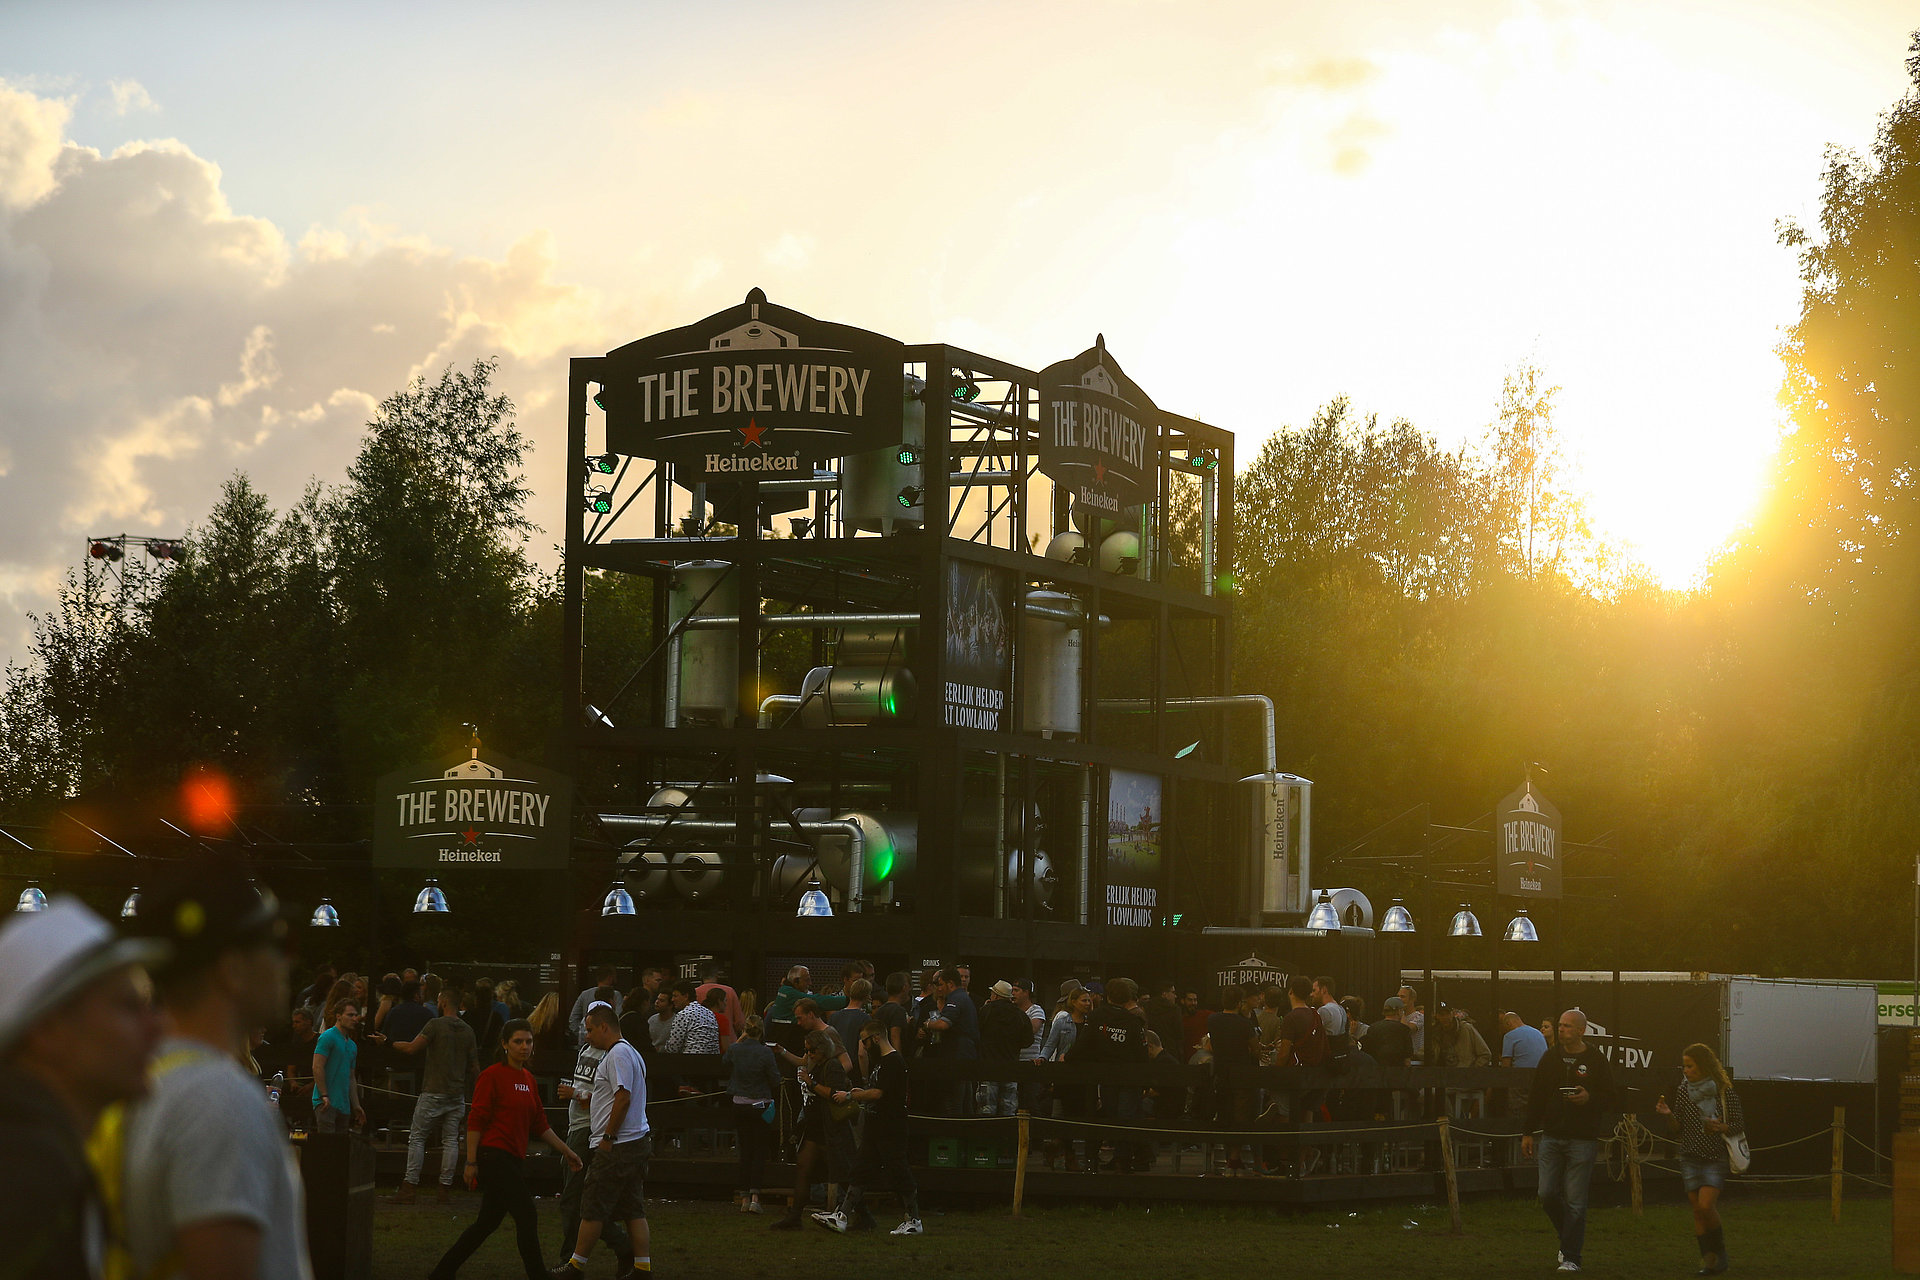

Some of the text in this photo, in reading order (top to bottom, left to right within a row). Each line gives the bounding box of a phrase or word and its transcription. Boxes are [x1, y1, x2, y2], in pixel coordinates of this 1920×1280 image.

[638, 363, 871, 423] THE BREWERY
[1052, 401, 1146, 471] THE BREWERY
[704, 453, 799, 473] Heineken
[1081, 486, 1118, 512] Heineken
[975, 687, 1004, 710] HELDER
[955, 706, 999, 732] LOWLANDS
[397, 789, 550, 827] THE BREWERY
[1273, 799, 1285, 860] Heineken
[1503, 821, 1555, 859] THE BREWERY
[438, 849, 502, 862] Heineken
[1131, 887, 1157, 907] HELDER
[1113, 907, 1152, 928] LOWLANDS
[680, 963, 697, 978] THE
[1217, 970, 1289, 988] THE BREWERY
[1878, 1004, 1920, 1017] erse
[1110, 1033, 1126, 1042] 40
[514, 1083, 530, 1092] PIZZA
